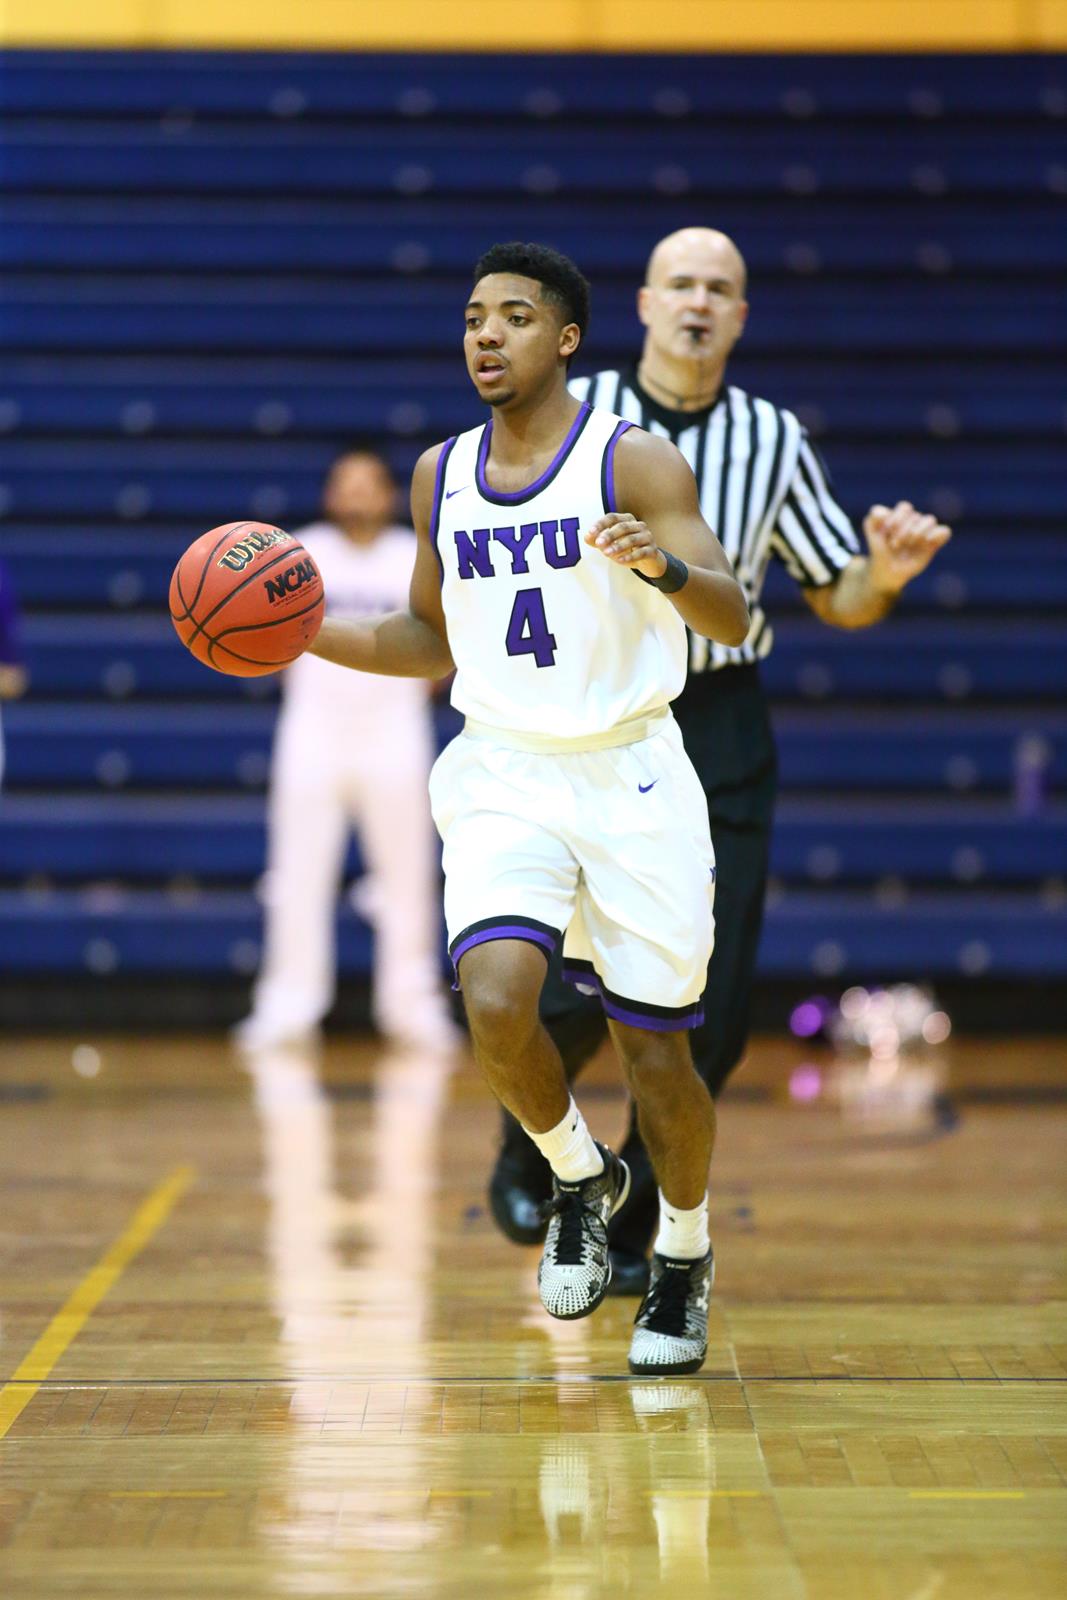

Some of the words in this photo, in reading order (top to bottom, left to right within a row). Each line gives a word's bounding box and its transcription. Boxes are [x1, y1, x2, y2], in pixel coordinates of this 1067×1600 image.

[454, 517, 582, 580] NYU
[264, 557, 317, 604] NCAA
[505, 587, 557, 669] 4
